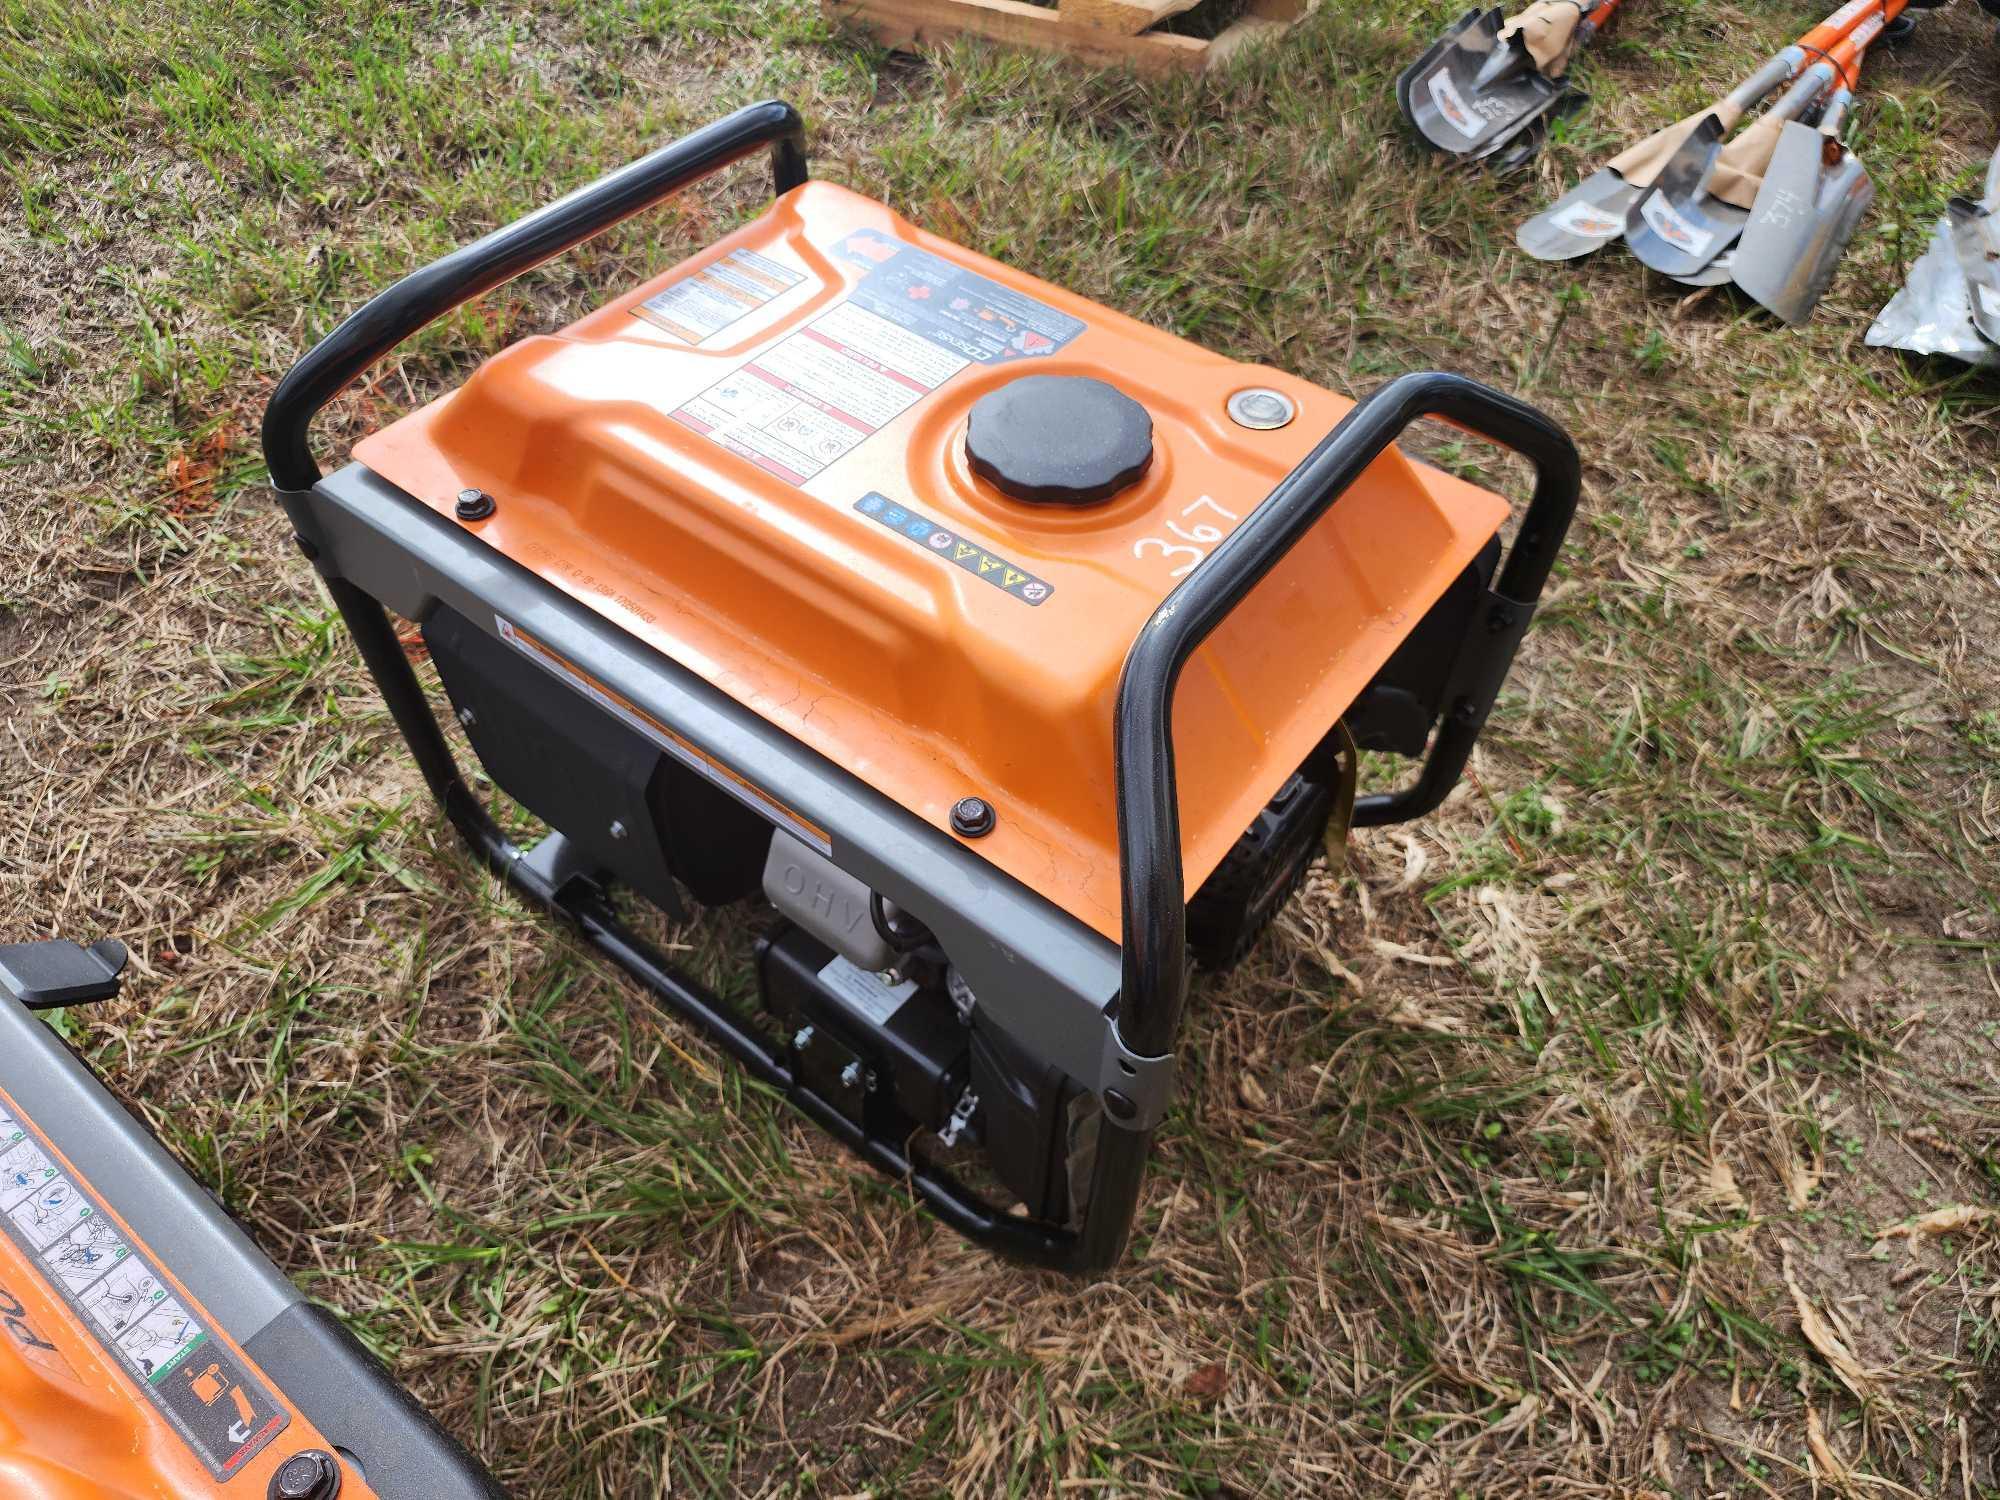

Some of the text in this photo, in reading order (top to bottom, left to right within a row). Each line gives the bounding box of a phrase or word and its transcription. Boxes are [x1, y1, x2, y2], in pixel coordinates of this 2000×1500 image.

[1133, 495, 1237, 577] 367
[785, 865, 864, 934] OHV
[165, 1346, 192, 1371] START
